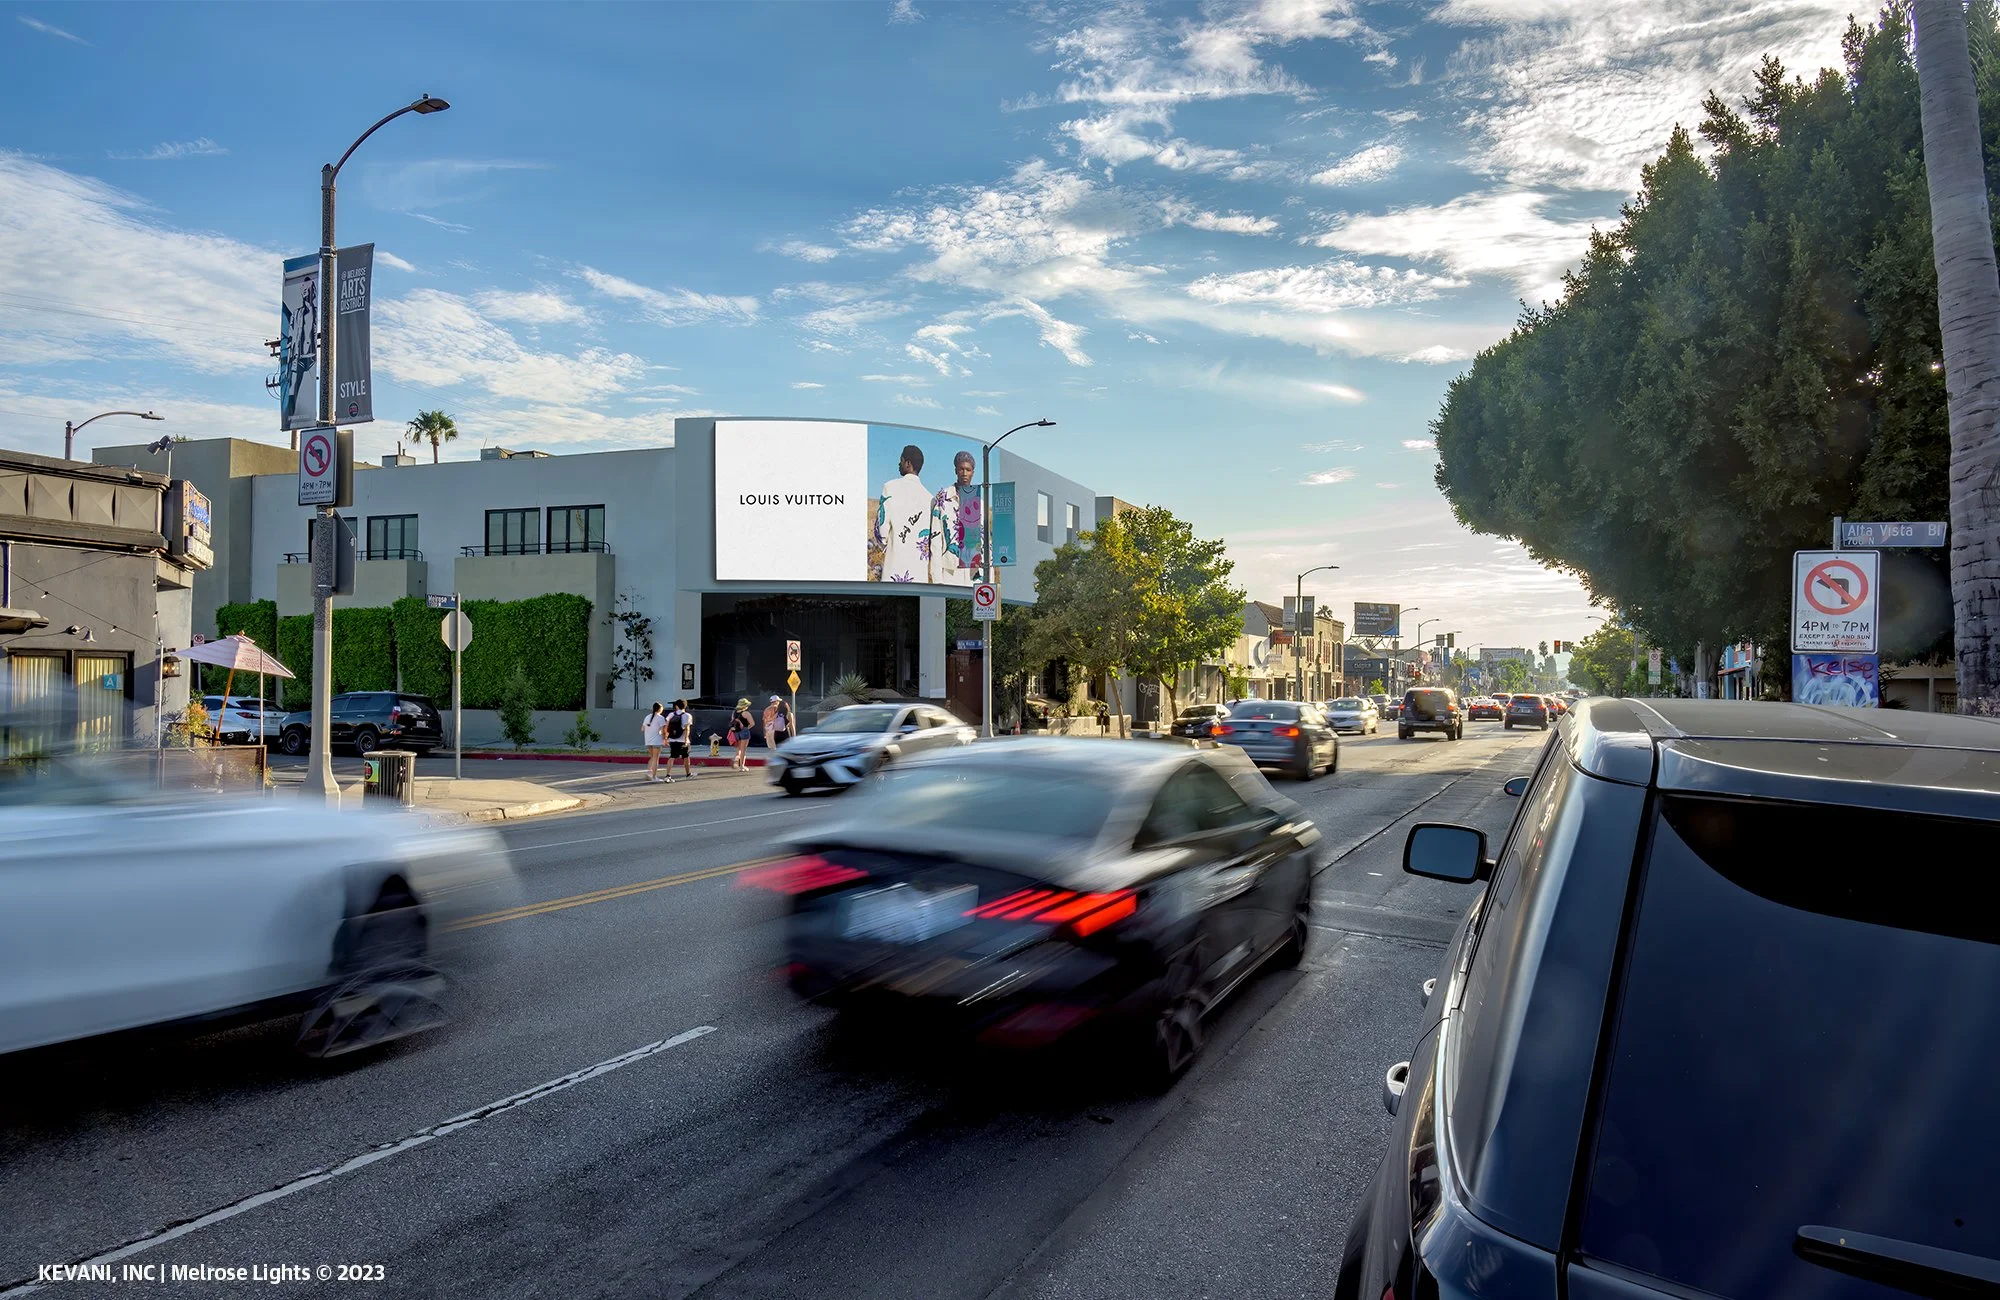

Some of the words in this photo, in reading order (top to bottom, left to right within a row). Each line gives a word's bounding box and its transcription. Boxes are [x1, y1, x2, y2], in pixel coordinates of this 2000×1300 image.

[340, 276, 366, 299] ARTS
[340, 295, 366, 311] DISTRICT
[340, 379, 366, 399] STYLE
[301, 481, 315, 490] 4PM
[318, 480, 332, 489] 7PM
[740, 494, 780, 505] LOUIS
[784, 494, 844, 505] VUITTON
[1847, 524, 1873, 537] Alta
[1879, 524, 1913, 537] Vista
[1928, 523, 1940, 536] Bl
[1868, 537, 1875, 545] N
[1801, 620, 1830, 632] 4PM
[1841, 620, 1870, 632] 7PM
[106, 677, 115, 687] A
